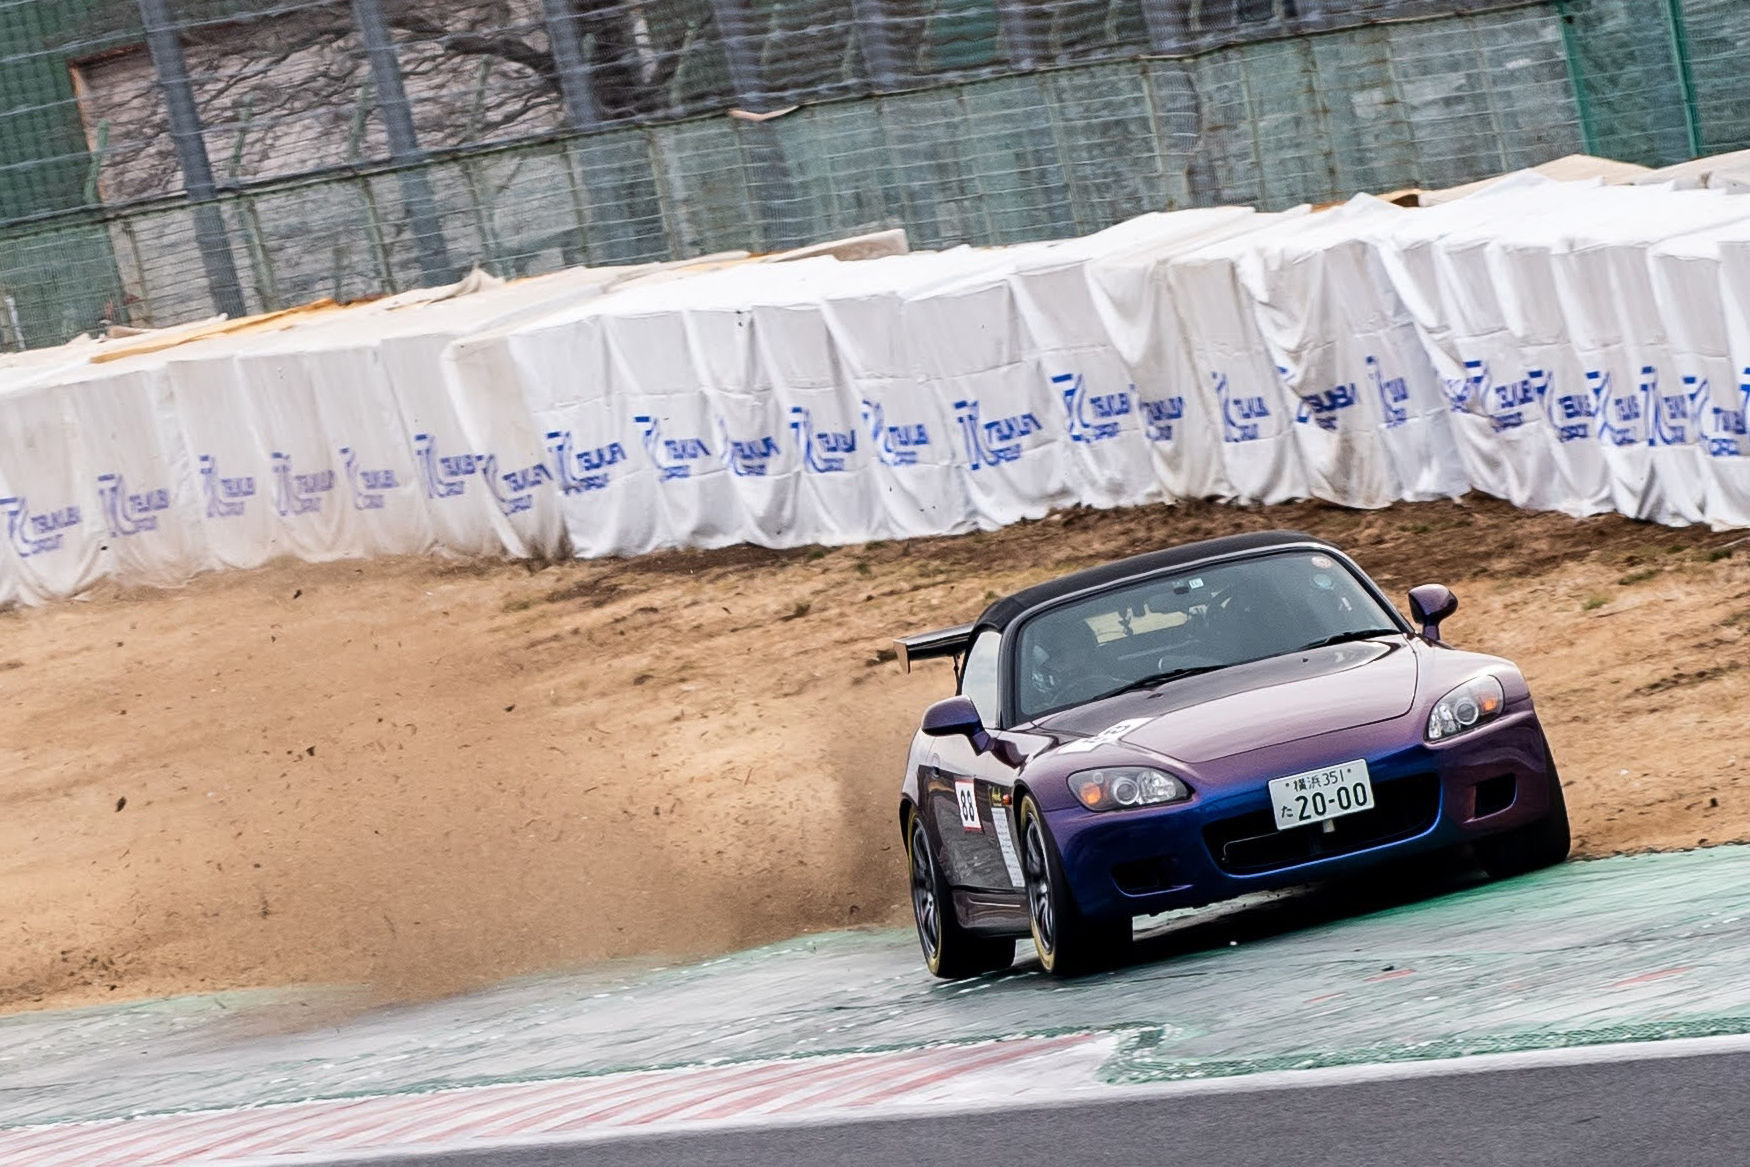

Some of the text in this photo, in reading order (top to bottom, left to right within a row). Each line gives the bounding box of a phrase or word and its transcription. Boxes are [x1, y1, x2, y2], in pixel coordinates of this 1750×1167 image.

[960, 789, 975, 822] 88
[1281, 782, 1368, 821] た 20-00
